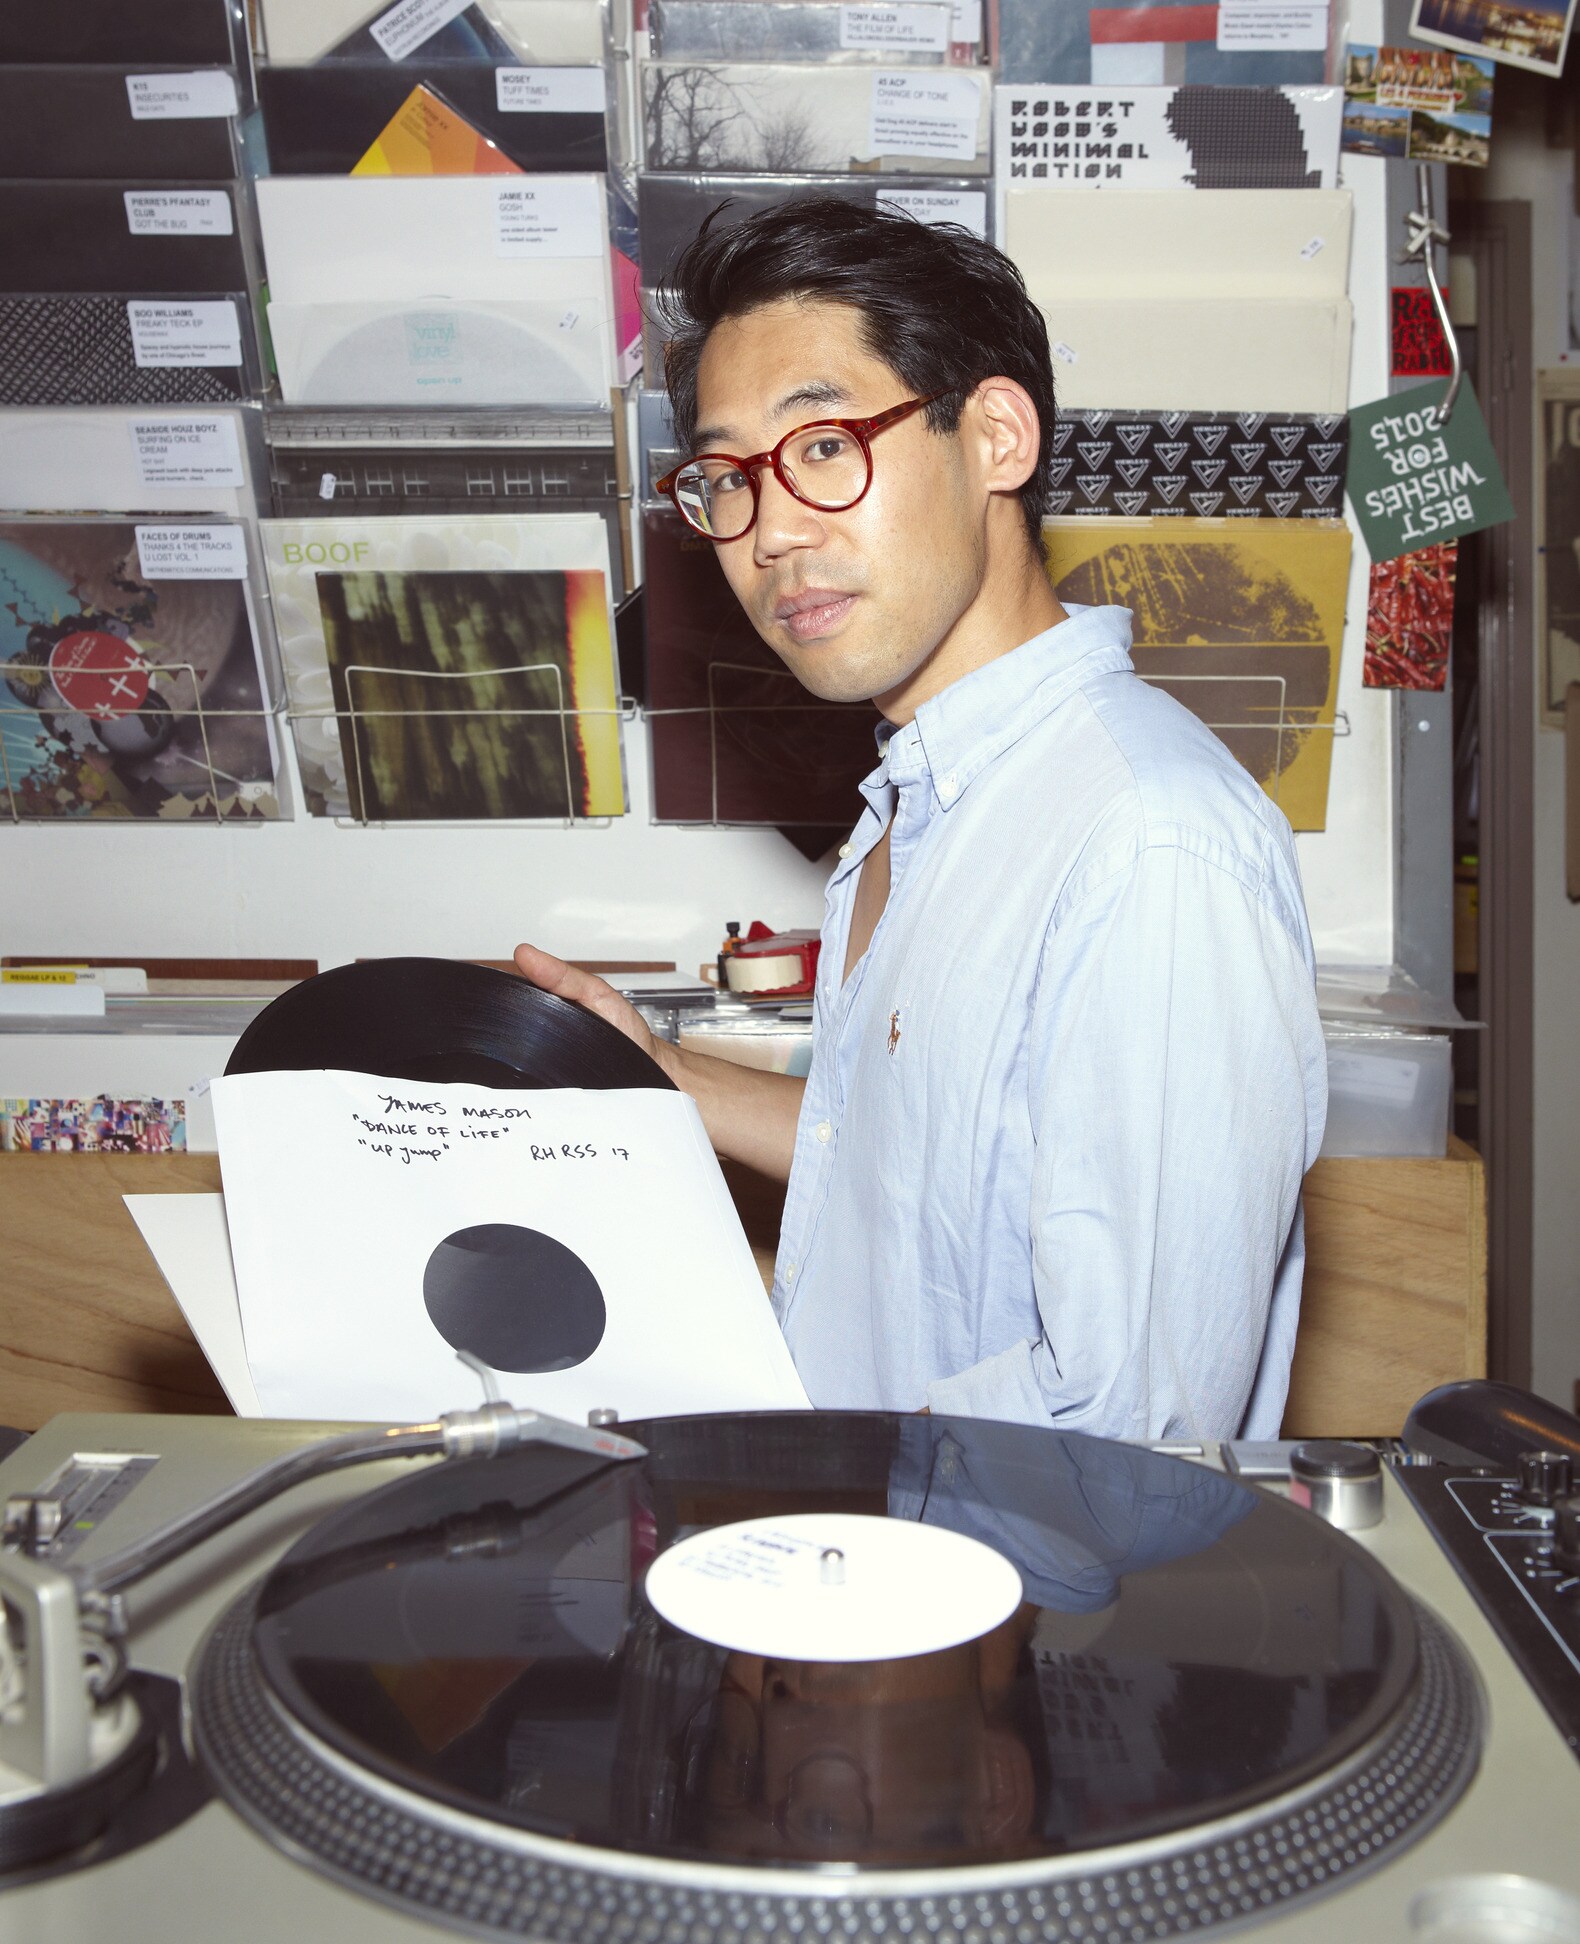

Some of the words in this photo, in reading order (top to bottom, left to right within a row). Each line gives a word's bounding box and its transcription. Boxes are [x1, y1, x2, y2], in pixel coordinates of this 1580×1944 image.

[871, 13, 897, 22] ALLEN
[502, 75, 531, 84] MOSEY
[503, 86, 523, 95] TUFF
[525, 87, 550, 96] TIMES
[877, 88, 911, 99] CHANGE
[913, 91, 924, 99] OF
[926, 91, 949, 102] TONE
[498, 191, 523, 201] JAMIE
[524, 191, 536, 201] XX
[913, 197, 925, 206] ON
[927, 198, 960, 206] SUNDAY
[498, 203, 523, 212] GOSH
[133, 209, 156, 217] CLUB
[134, 220, 151, 229] GOT
[153, 220, 169, 229] THE
[170, 220, 188, 229] BUG
[134, 309, 153, 318] BOO
[154, 309, 193, 318] WILLIAMS
[136, 319, 168, 328] FREAKY
[169, 319, 191, 328] TECK
[192, 319, 204, 328] EP
[414, 321, 457, 343] vinyl
[416, 376, 445, 386] open
[448, 376, 462, 385] up
[135, 424, 169, 435] SEASIDE
[170, 423, 194, 434] HOUZ
[195, 422, 218, 433] BOYZ
[1370, 405, 1442, 450] 2015
[137, 434, 173, 444] SURFING
[174, 434, 187, 443] ON
[188, 434, 202, 443] ICE
[139, 445, 168, 454] CREAM
[1383, 436, 1449, 475] FOR
[1365, 461, 1487, 518] WISHES
[1401, 494, 1475, 544] BEST
[141, 531, 168, 541] FACES
[169, 532, 181, 541] OF
[182, 531, 212, 540] DRUMS
[143, 542, 175, 551] THANKS
[183, 542, 198, 551] THE
[201, 541, 233, 550] TRACKS
[144, 553, 151, 561] U
[152, 553, 173, 561] LOST
[282, 541, 370, 564] BOOF
[9, 973, 39, 982] REGGAE
[40, 973, 50, 982] LP
[75, 972, 96, 981] CHNO
[377, 1094, 447, 1115] JAMES
[462, 1106, 532, 1119] MASON
[427, 1126, 450, 1138] OF
[530, 1145, 556, 1161] RH
[562, 1143, 597, 1160] RSS
[612, 1147, 630, 1161] 17
